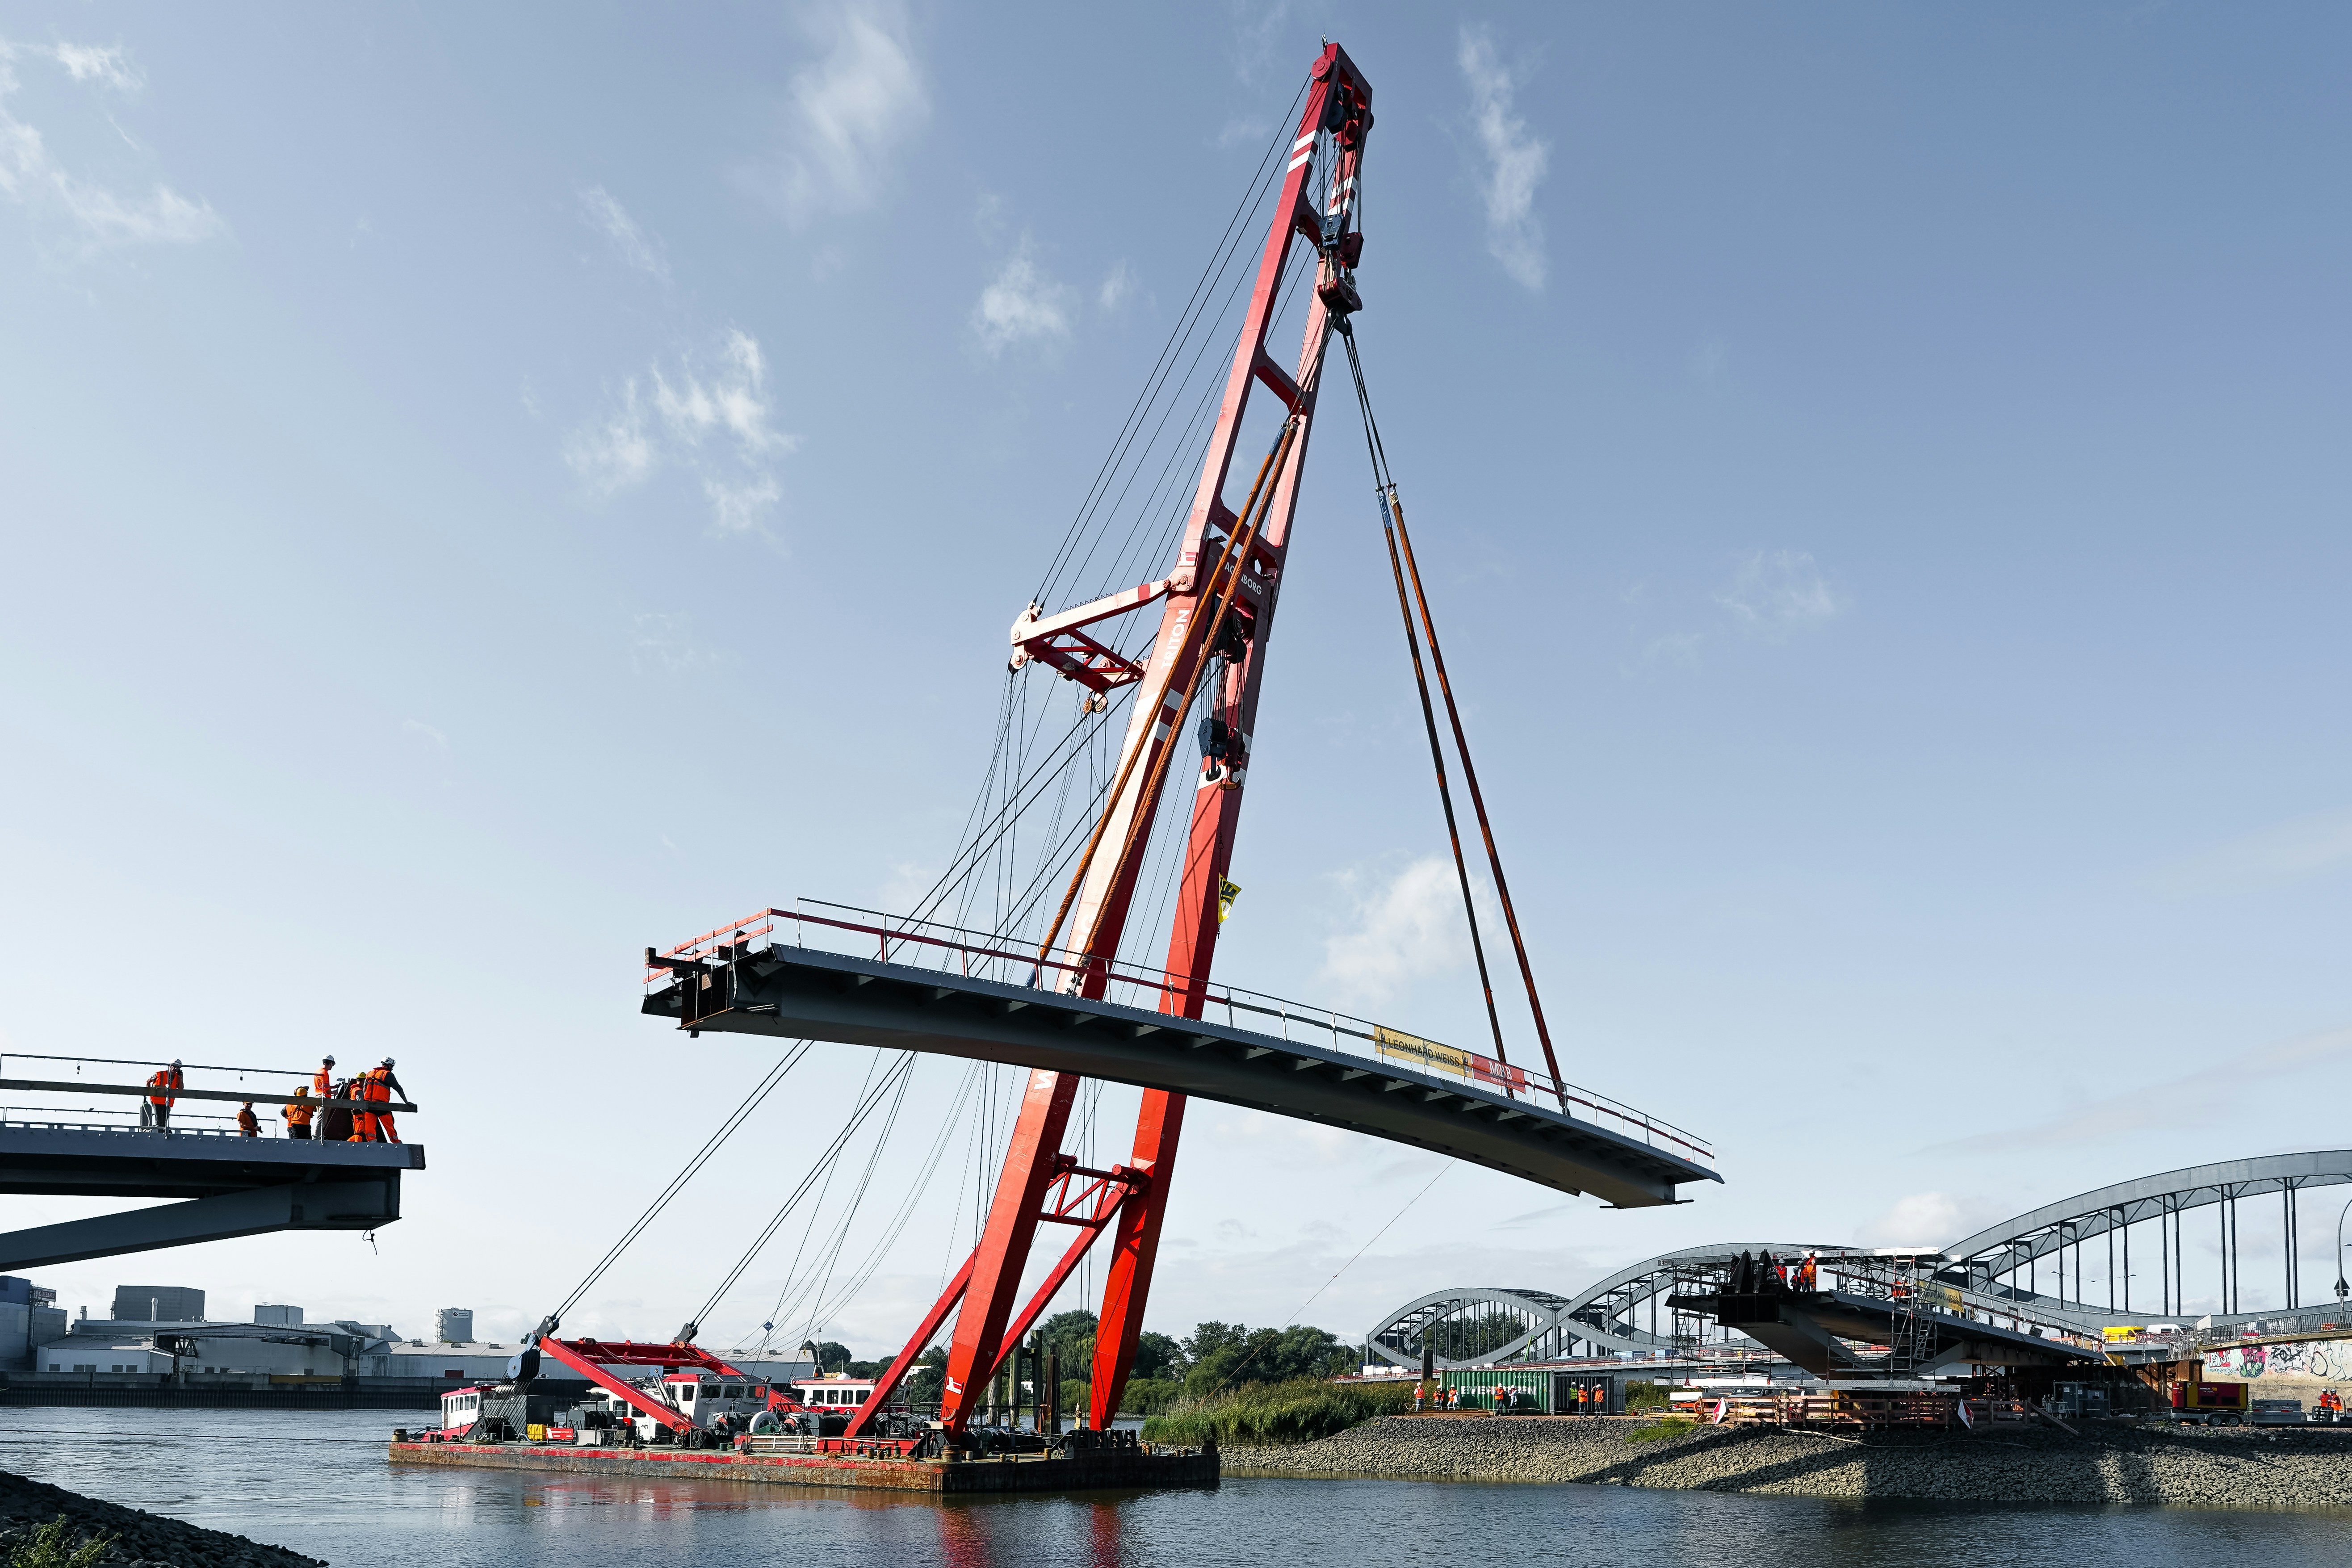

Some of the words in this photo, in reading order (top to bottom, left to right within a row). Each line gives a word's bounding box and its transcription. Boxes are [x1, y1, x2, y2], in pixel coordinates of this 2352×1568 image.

[1219, 556, 1262, 595] AGBORG
[1160, 609, 1191, 669] TRITON
[1388, 1038, 1434, 1059] LEONHARD
[1435, 1051, 1459, 1067] WEISS
[1488, 1061, 1512, 1080] MBB
